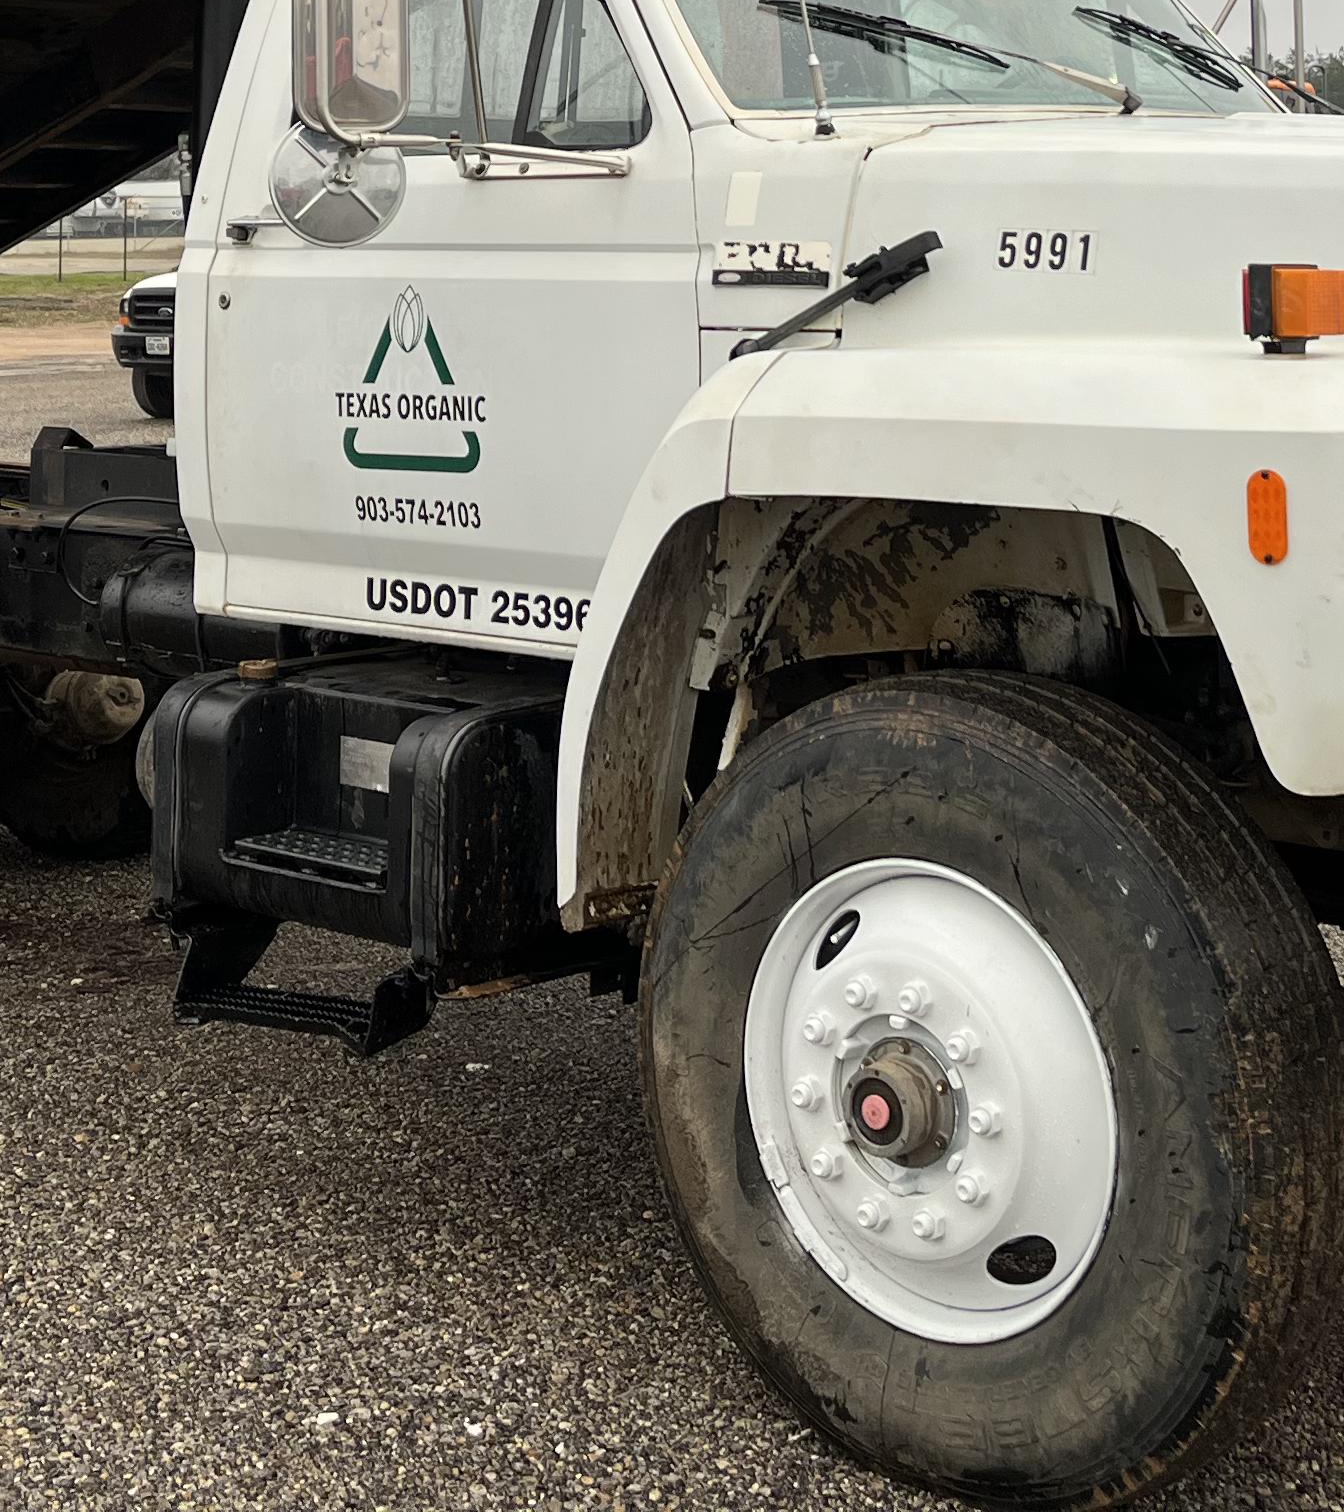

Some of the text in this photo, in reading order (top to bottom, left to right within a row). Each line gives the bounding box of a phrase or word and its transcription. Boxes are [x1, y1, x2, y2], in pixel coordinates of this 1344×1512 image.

[998, 231, 1091, 271] 5991
[752, 272, 821, 284] DIESEL
[335, 391, 487, 422] TEXAS ORGANIC
[355, 495, 482, 529] 903-574-2103
[367, 577, 479, 620] USDOT
